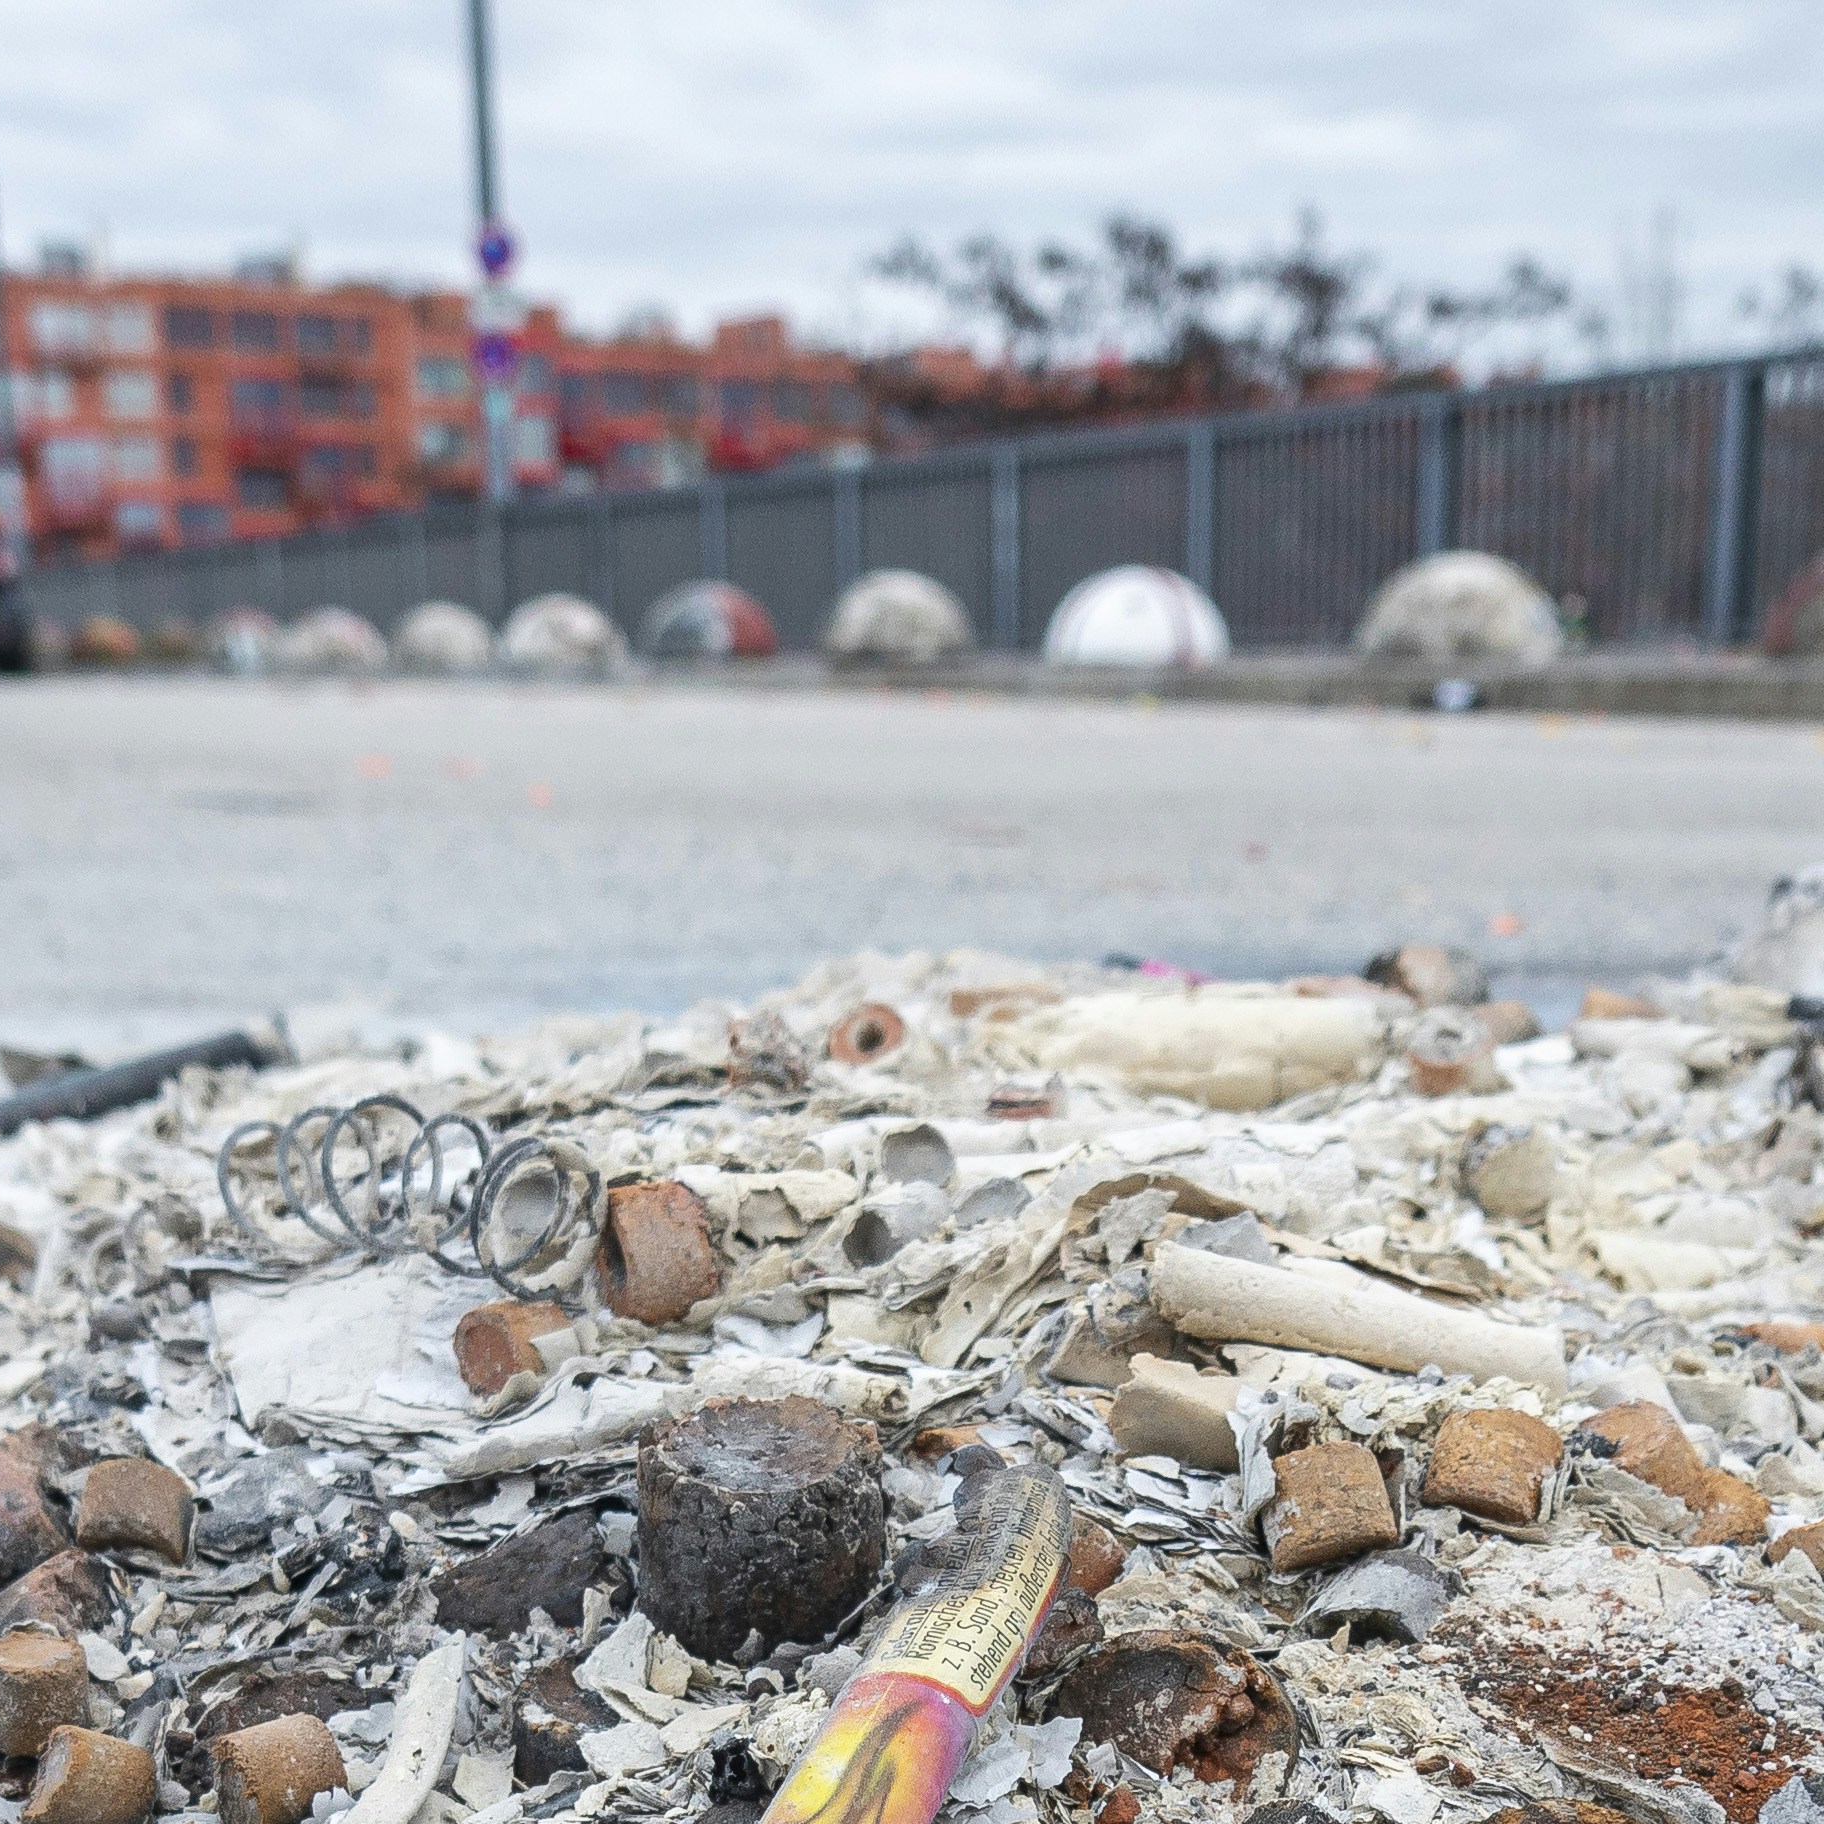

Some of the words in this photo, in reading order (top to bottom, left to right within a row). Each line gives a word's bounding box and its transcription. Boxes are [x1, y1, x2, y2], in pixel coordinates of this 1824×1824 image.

[987, 1543, 1029, 1594] stecken.
[906, 1595, 969, 1660] Römisches
[956, 1597, 1004, 1634] Sand,
[941, 1657, 965, 1671] z.
[945, 1638, 976, 1652] B.
[971, 1624, 1012, 1692] stehend
